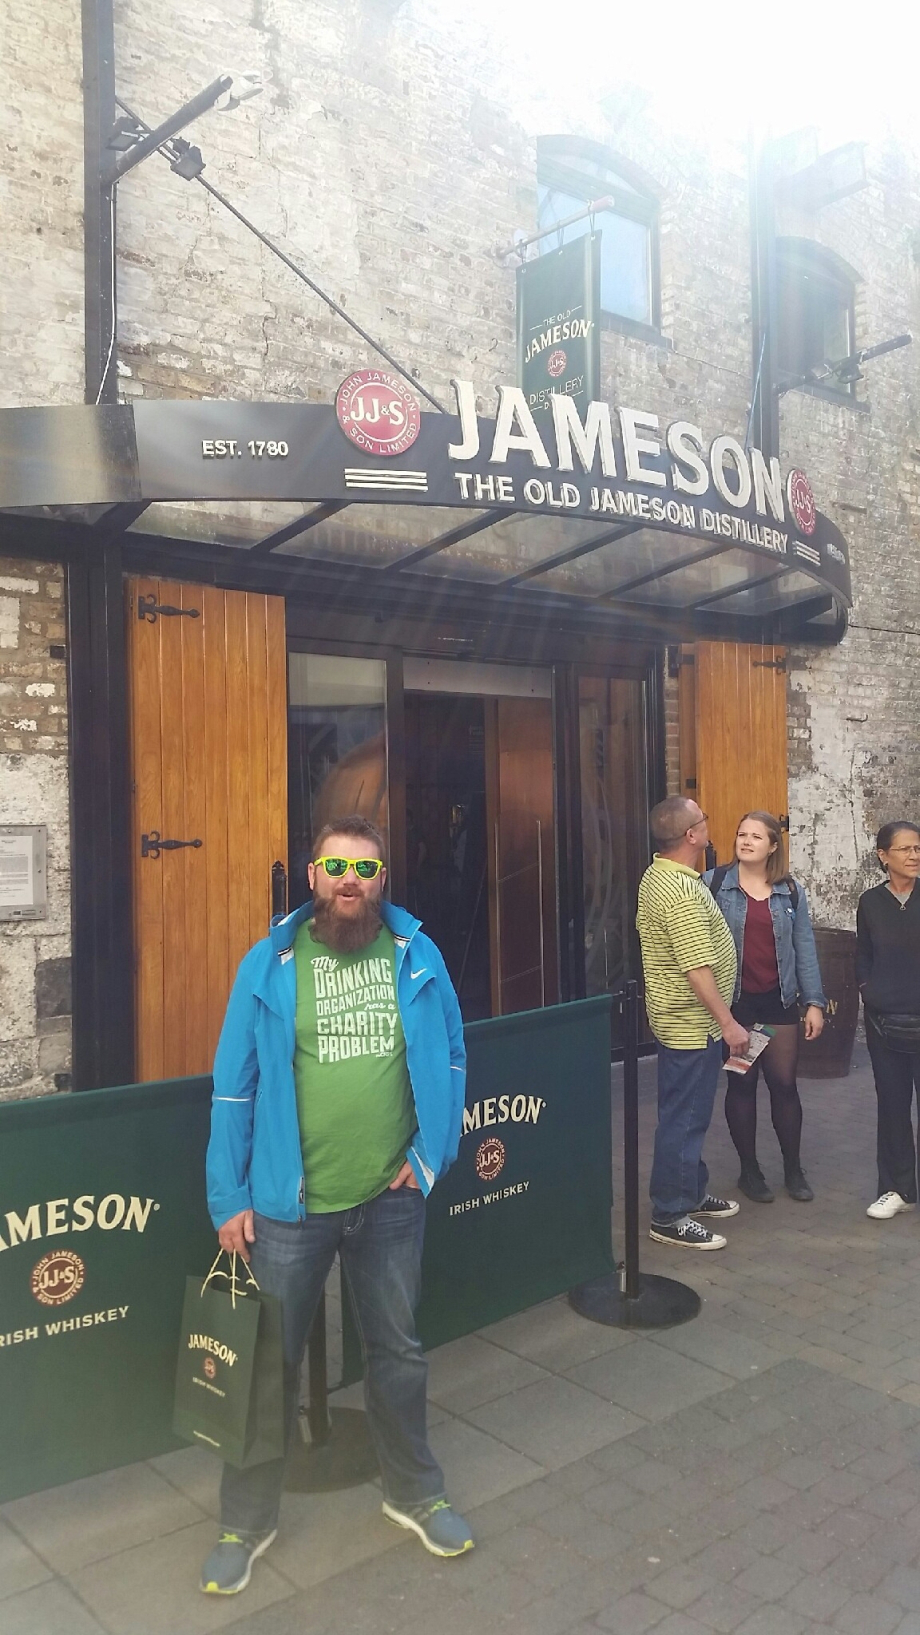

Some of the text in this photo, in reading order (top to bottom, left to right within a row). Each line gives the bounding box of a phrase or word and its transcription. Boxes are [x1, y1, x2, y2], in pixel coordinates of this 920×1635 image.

[543, 309, 571, 327] THE OLD
[525, 318, 592, 363] JAMESON
[340, 372, 417, 411] JOHN JAMESON
[350, 396, 405, 426] JJ&S
[202, 439, 289, 457] EST. 1780
[350, 427, 374, 450] SON
[379, 423, 417, 453] LIMITED
[448, 379, 785, 523] JAMESON
[454, 472, 515, 503] THE
[524, 478, 581, 509] OLD
[589, 486, 696, 529] JAMESON
[700, 508, 789, 554] DISTILLERY
[310, 956, 339, 972] My
[313, 957, 393, 998] DRINKING
[316, 984, 396, 1016] ORGANIZATION
[364, 1002, 387, 1011] has
[317, 1010, 398, 1036] CHARITY
[317, 1035, 395, 1063] PROBLEM
[460, 1094, 544, 1137] MESON
[449, 1181, 530, 1216] IRISH WHISKEY
[51, 1251, 85, 1270] JAMESON
[45, 1305, 130, 1336] WHISKEY
[188, 1334, 237, 1367] JAMESON
